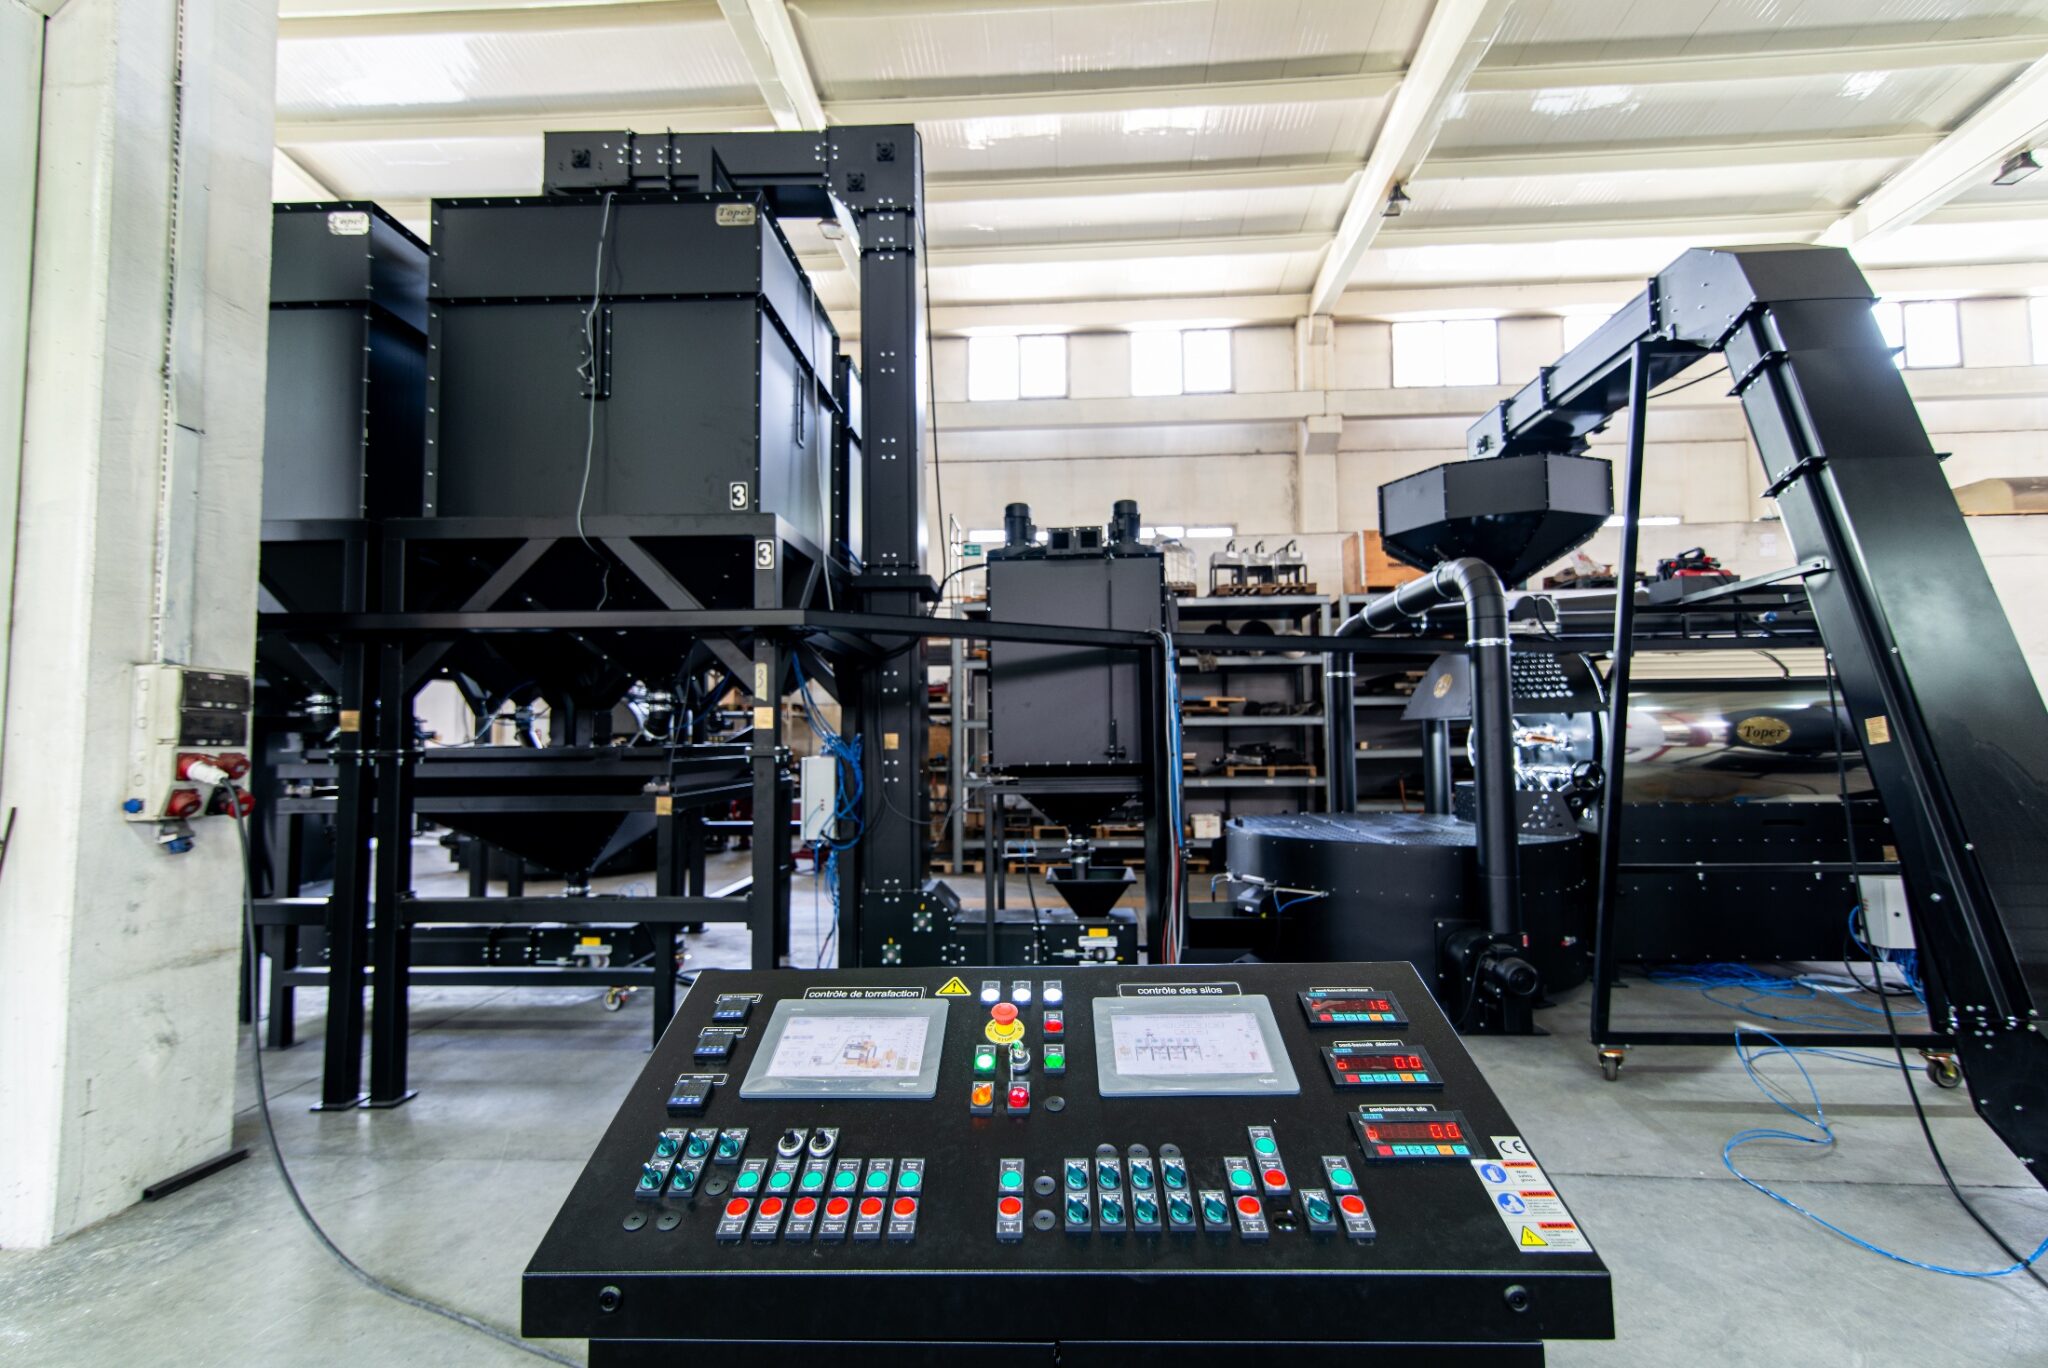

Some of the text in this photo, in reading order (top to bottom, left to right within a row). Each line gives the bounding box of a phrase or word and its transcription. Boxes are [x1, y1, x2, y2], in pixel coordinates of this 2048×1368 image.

[732, 485, 746, 507] 3
[757, 543, 772, 566] 3
[1744, 725, 1785, 739] Toper
[808, 989, 919, 998] contrôle de torrafaction
[1137, 986, 1223, 995] contrôle des silos
[1499, 1140, 1527, 1154] CE
